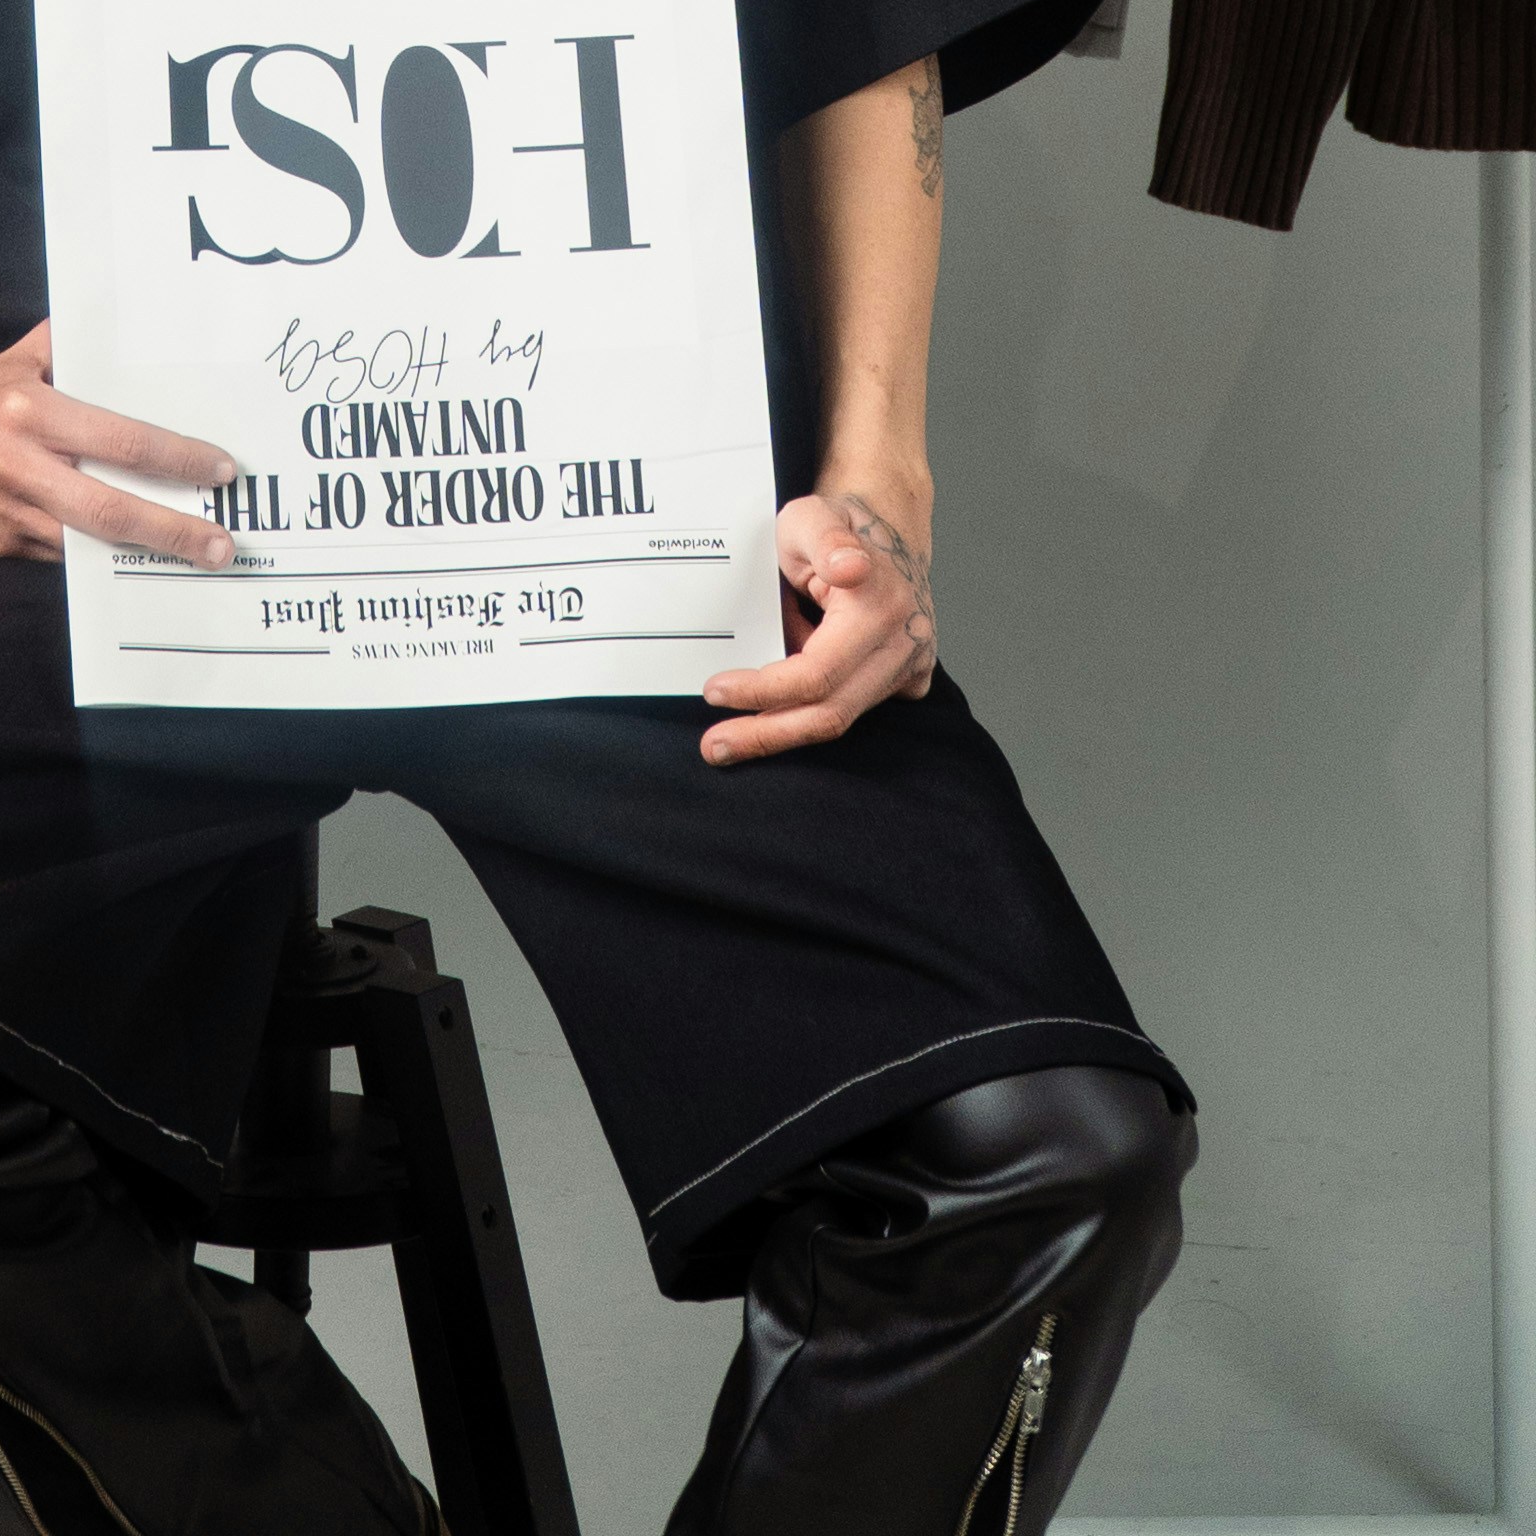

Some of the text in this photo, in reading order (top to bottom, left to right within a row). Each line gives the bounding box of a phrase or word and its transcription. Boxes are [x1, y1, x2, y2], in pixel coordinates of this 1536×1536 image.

[152, 34, 651, 266] HOSG
[265, 318, 544, 404] by HOSG
[302, 398, 527, 461] UNTAMED
[305, 472, 366, 531] OF
[381, 465, 544, 529] ORDER
[560, 459, 654, 519] THE
[112, 554, 145, 565] 2026
[233, 556, 275, 568] Friday
[649, 538, 726, 551] Worldwide
[260, 581, 584, 634] The Fashion Post
[352, 638, 494, 659] BREAKING NEWS
